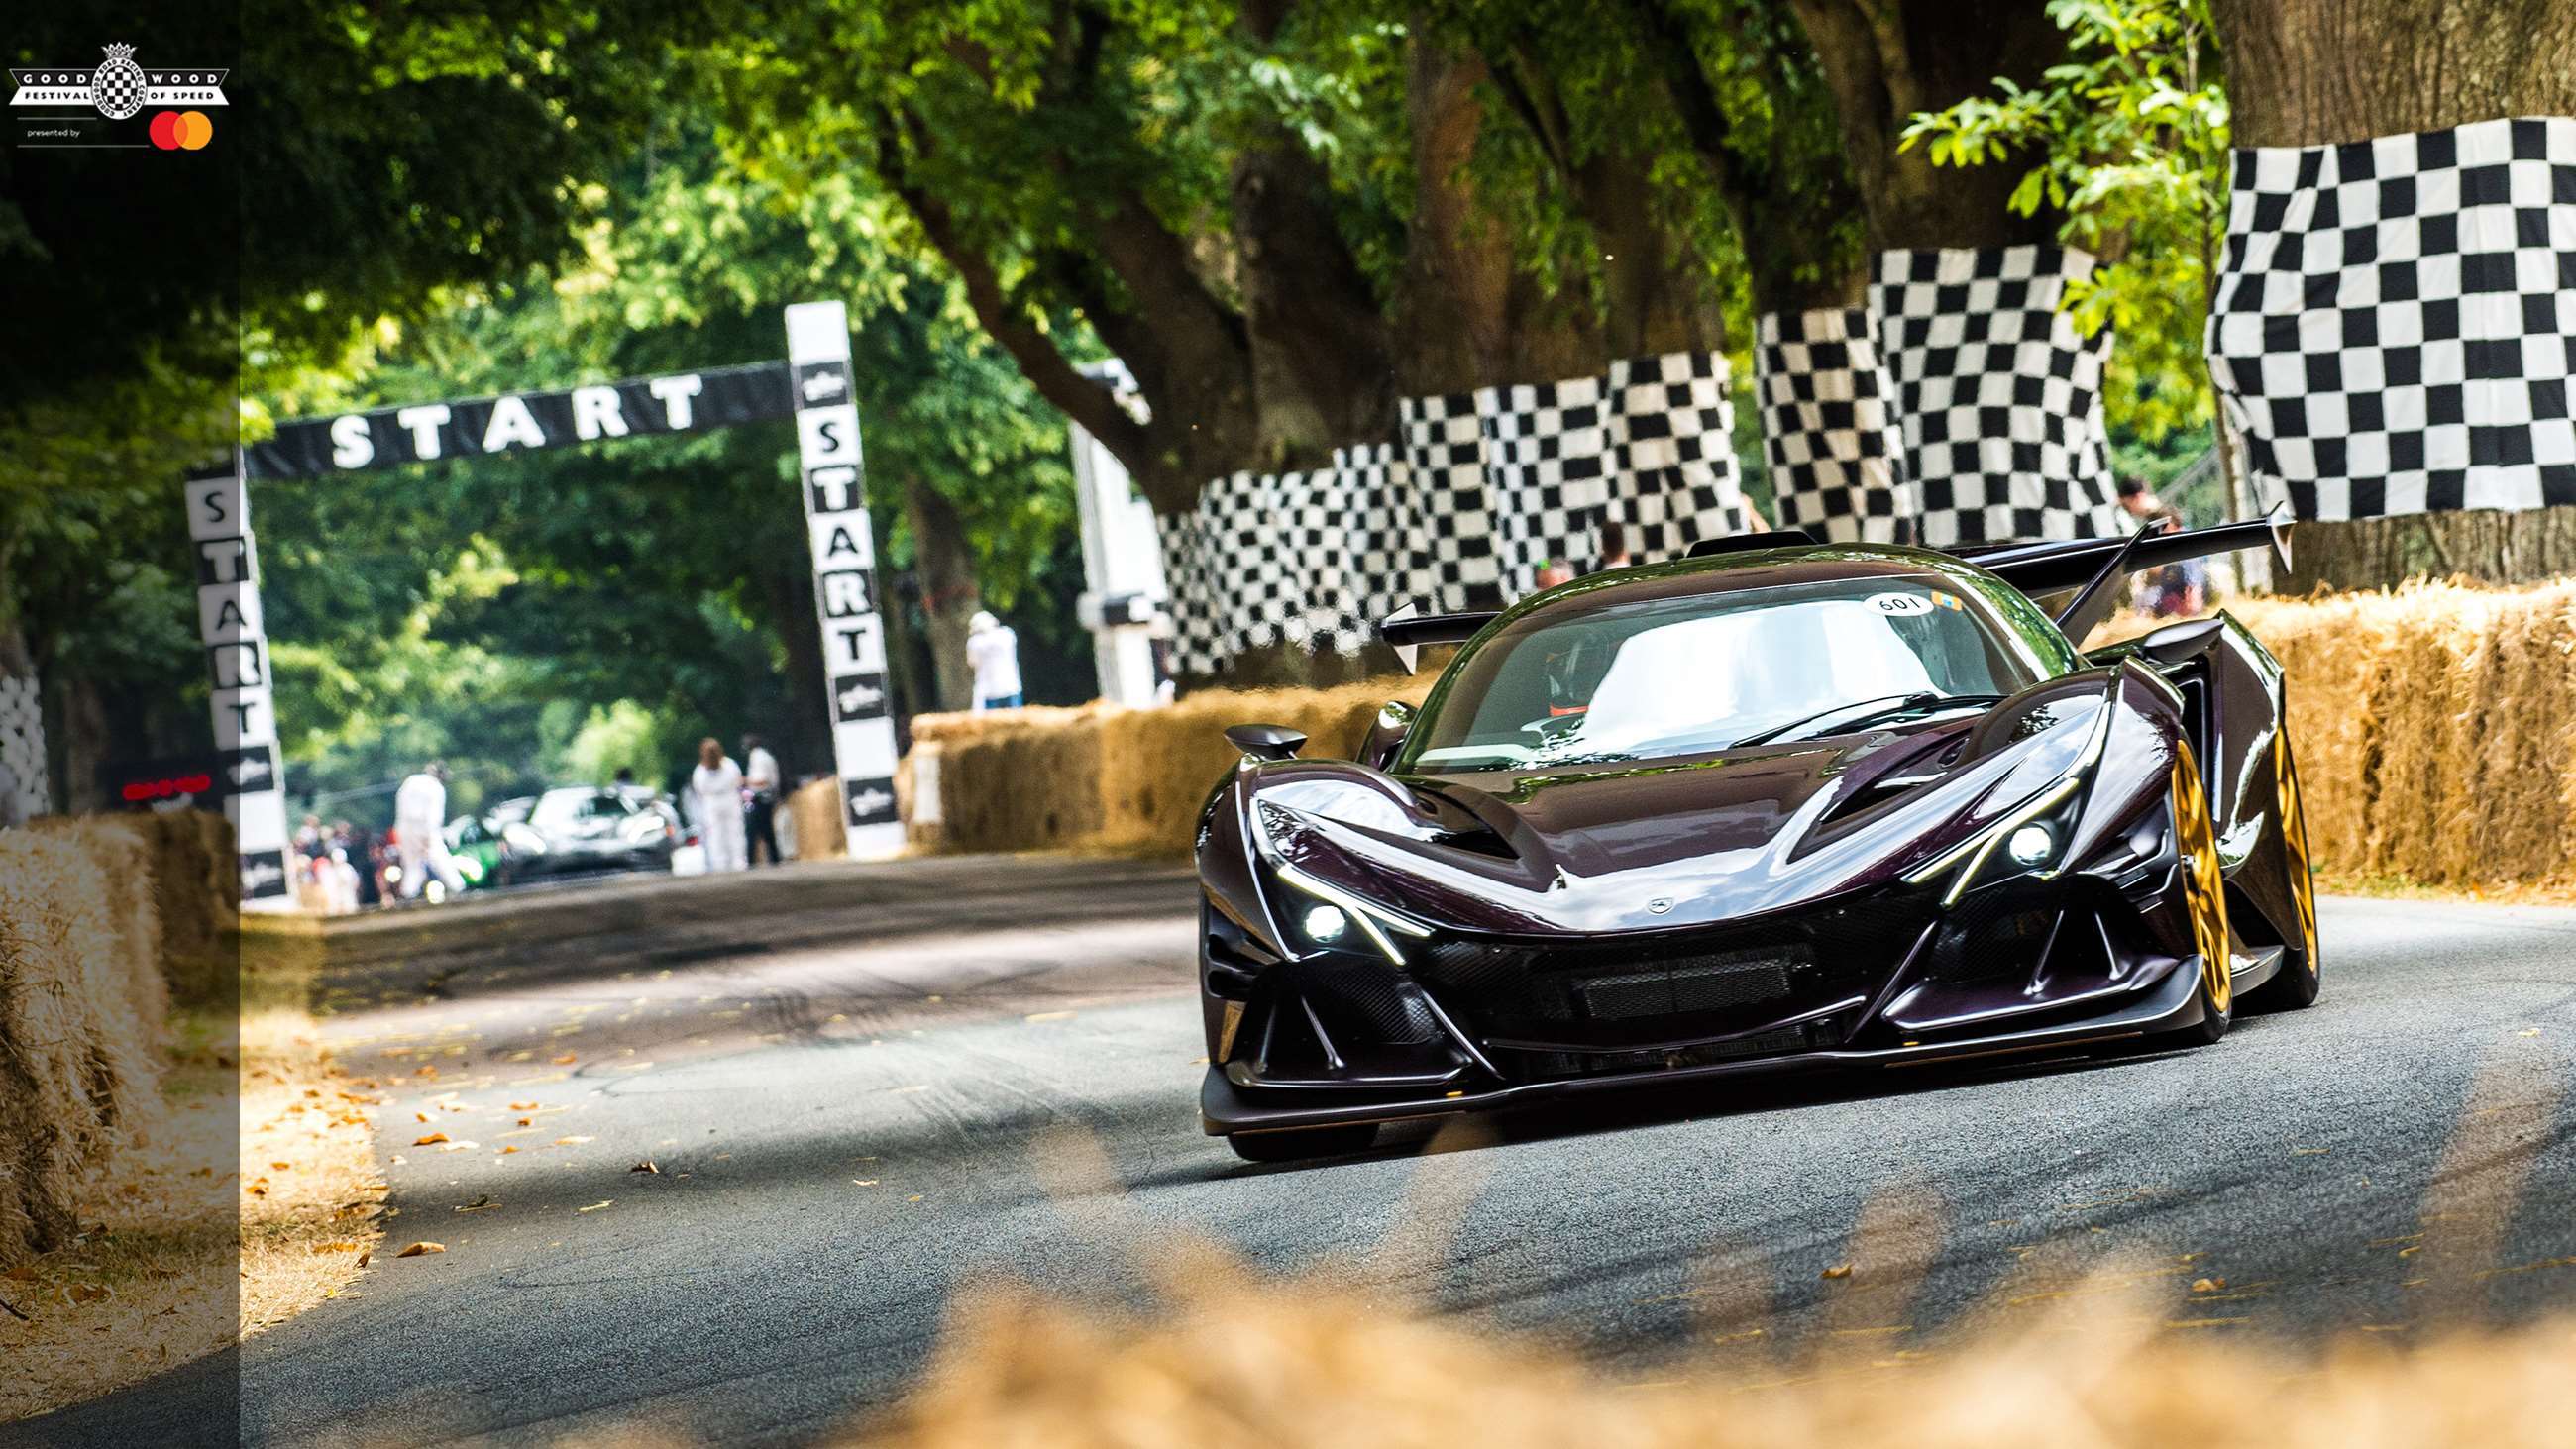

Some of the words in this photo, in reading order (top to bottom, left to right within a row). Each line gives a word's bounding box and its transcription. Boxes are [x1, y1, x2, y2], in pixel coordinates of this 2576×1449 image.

[330, 373, 702, 469] START
[201, 490, 262, 734] START
[812, 421, 873, 663] START
[1878, 597, 1921, 611] 601
